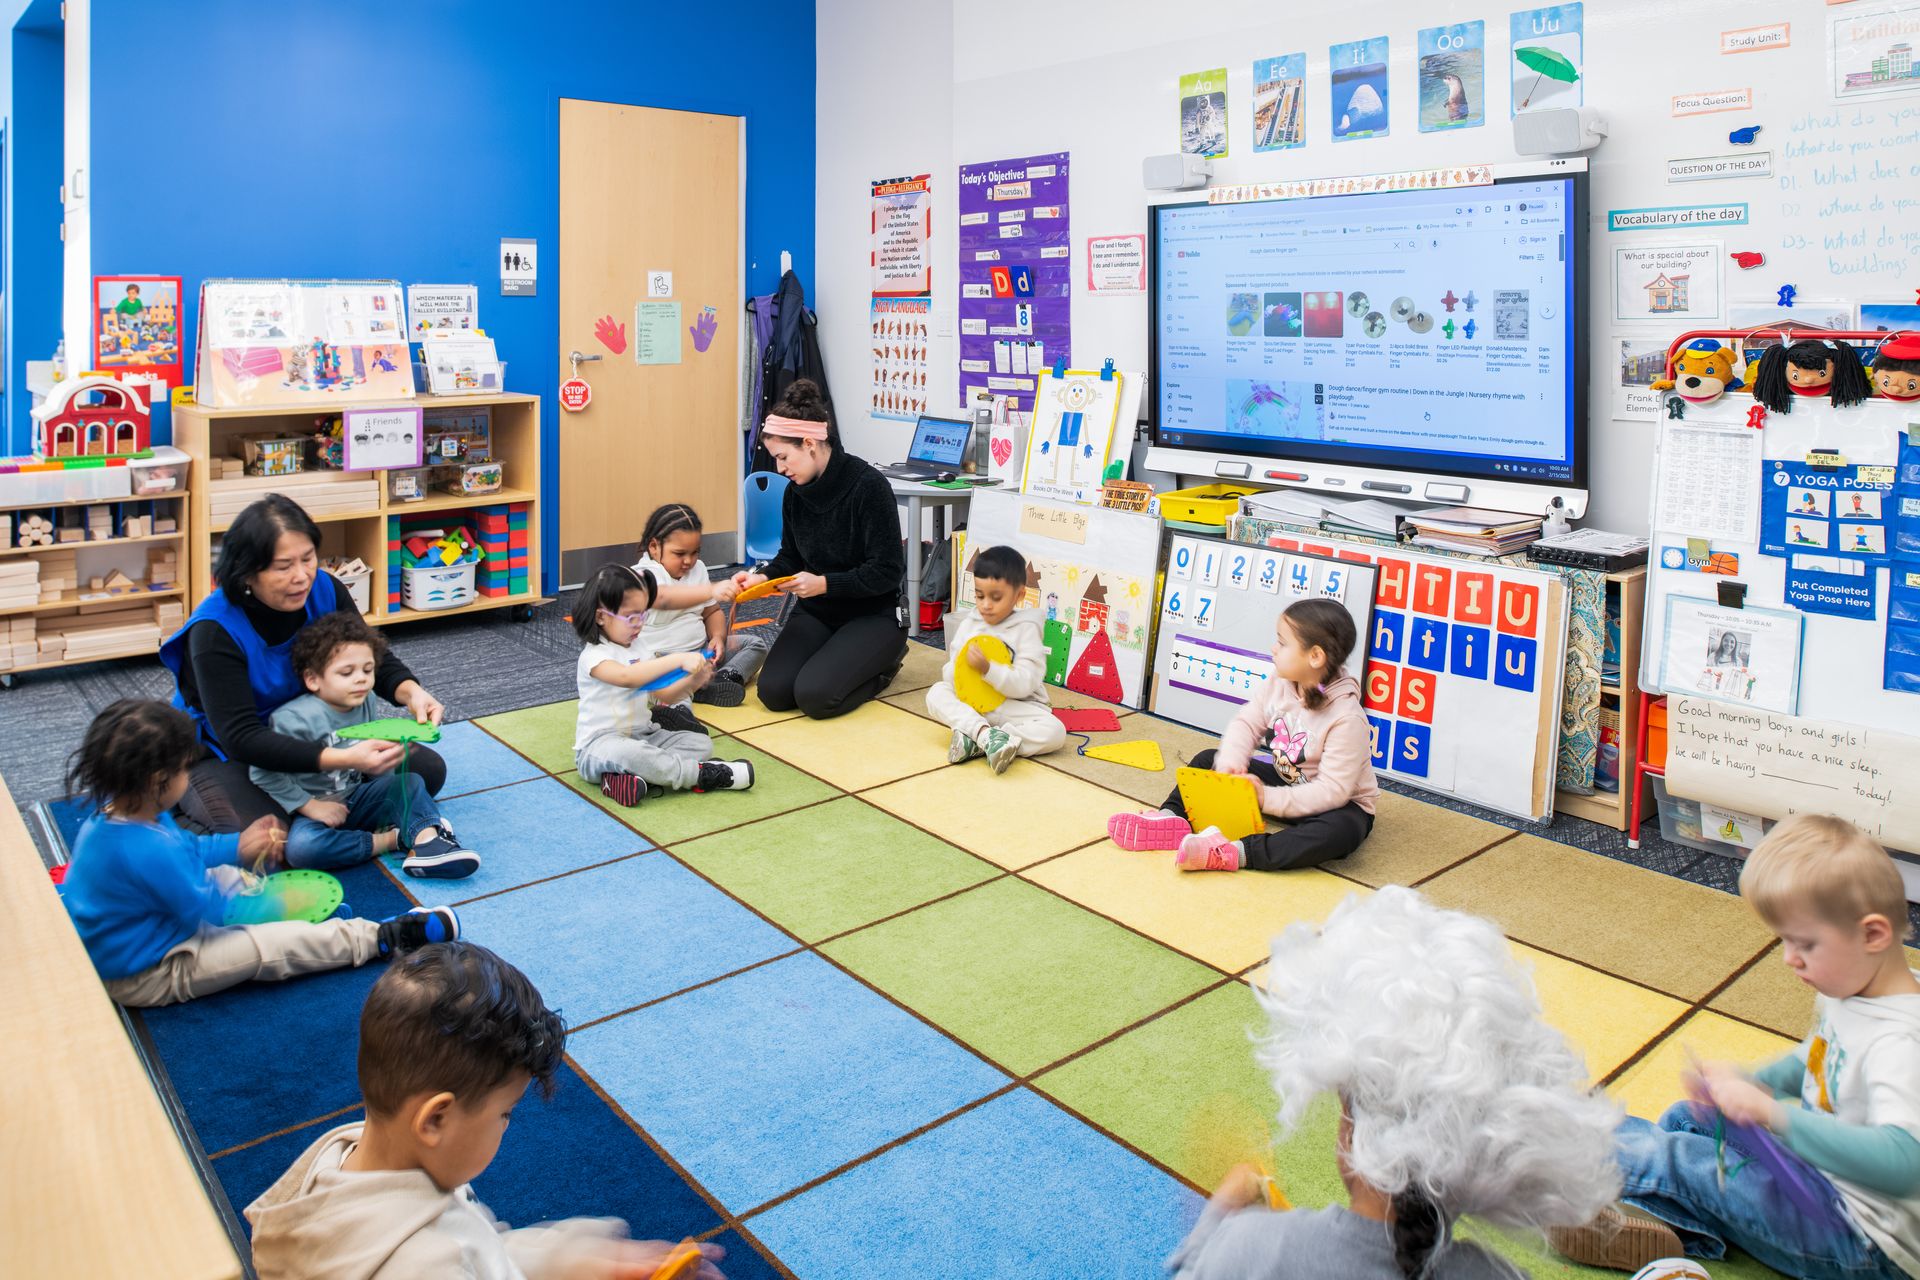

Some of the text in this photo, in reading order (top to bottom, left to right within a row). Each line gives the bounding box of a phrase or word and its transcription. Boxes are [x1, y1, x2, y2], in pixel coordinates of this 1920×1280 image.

[1532, 17, 1560, 35] Uu
[1437, 34, 1464, 50] Oo
[1730, 33, 1781, 47] Study Unit:
[1352, 49, 1365, 65] Ii
[1270, 64, 1287, 79] Ee
[1194, 79, 1212, 93] Aa
[1676, 95, 1746, 109] Focus Question:
[1670, 160, 1767, 175] QUESTION OF THE DAY
[961, 172, 987, 186] Today's
[988, 169, 1025, 185] Objectives
[997, 185, 1023, 197] Thursday
[1614, 208, 1742, 225] Vocabulary of the day
[1624, 250, 1710, 261] What is special about
[1656, 260, 1692, 270] building?
[994, 271, 1030, 293] D d
[873, 299, 928, 314] SIGN LANGUAGE
[1020, 310, 1028, 326] 8
[564, 386, 586, 395] STOP
[1328, 384, 1345, 392] Dough
[1345, 385, 1378, 394] dance/finger
[1390, 387, 1409, 395] routine
[1412, 388, 1429, 396] Down
[1435, 389, 1445, 397] the
[1446, 390, 1465, 399] Jungle
[1469, 391, 1491, 400] Nursery
[1492, 392, 1512, 401] rhyme
[1328, 394, 1355, 402] playdough
[1627, 393, 1653, 403] Frank
[372, 416, 403, 426] Friends
[1778, 474, 1894, 491] 7 YOGA POSES
[1061, 488, 1074, 496] Week
[1105, 489, 1147, 501] THE TRUE STORY OF
[1103, 499, 1112, 508] THE
[1111, 500, 1116, 509] 3
[1116, 500, 1131, 510] LITTLE
[1051, 509, 1068, 524] Little
[1176, 547, 1190, 568] 0
[1232, 555, 1246, 577] 2
[1262, 558, 1276, 580] 3
[1292, 563, 1308, 587] 4
[1325, 570, 1341, 593] 5
[1687, 556, 1712, 568] Gym
[1378, 565, 1532, 627] H T I U
[1791, 580, 1869, 597] Put Completed
[1168, 591, 1212, 618] 6 7
[1789, 590, 1871, 609] Yoga Pose Here
[1375, 617, 1526, 677] h t i u
[1172, 661, 1250, 689] 0 1 2 3 4 5
[1366, 669, 1426, 713] G S
[1677, 699, 1712, 718] Good
[1718, 711, 1761, 732] morning
[1767, 714, 1793, 738] boys
[1801, 726, 1824, 740] and
[1402, 735, 1420, 761] s
[1676, 721, 1883, 779] I hope that you have a nice sleep.
[1691, 750, 1706, 762] will
[1711, 752, 1721, 767] be
[1726, 756, 1756, 778] having
[1853, 781, 1893, 807] today!
